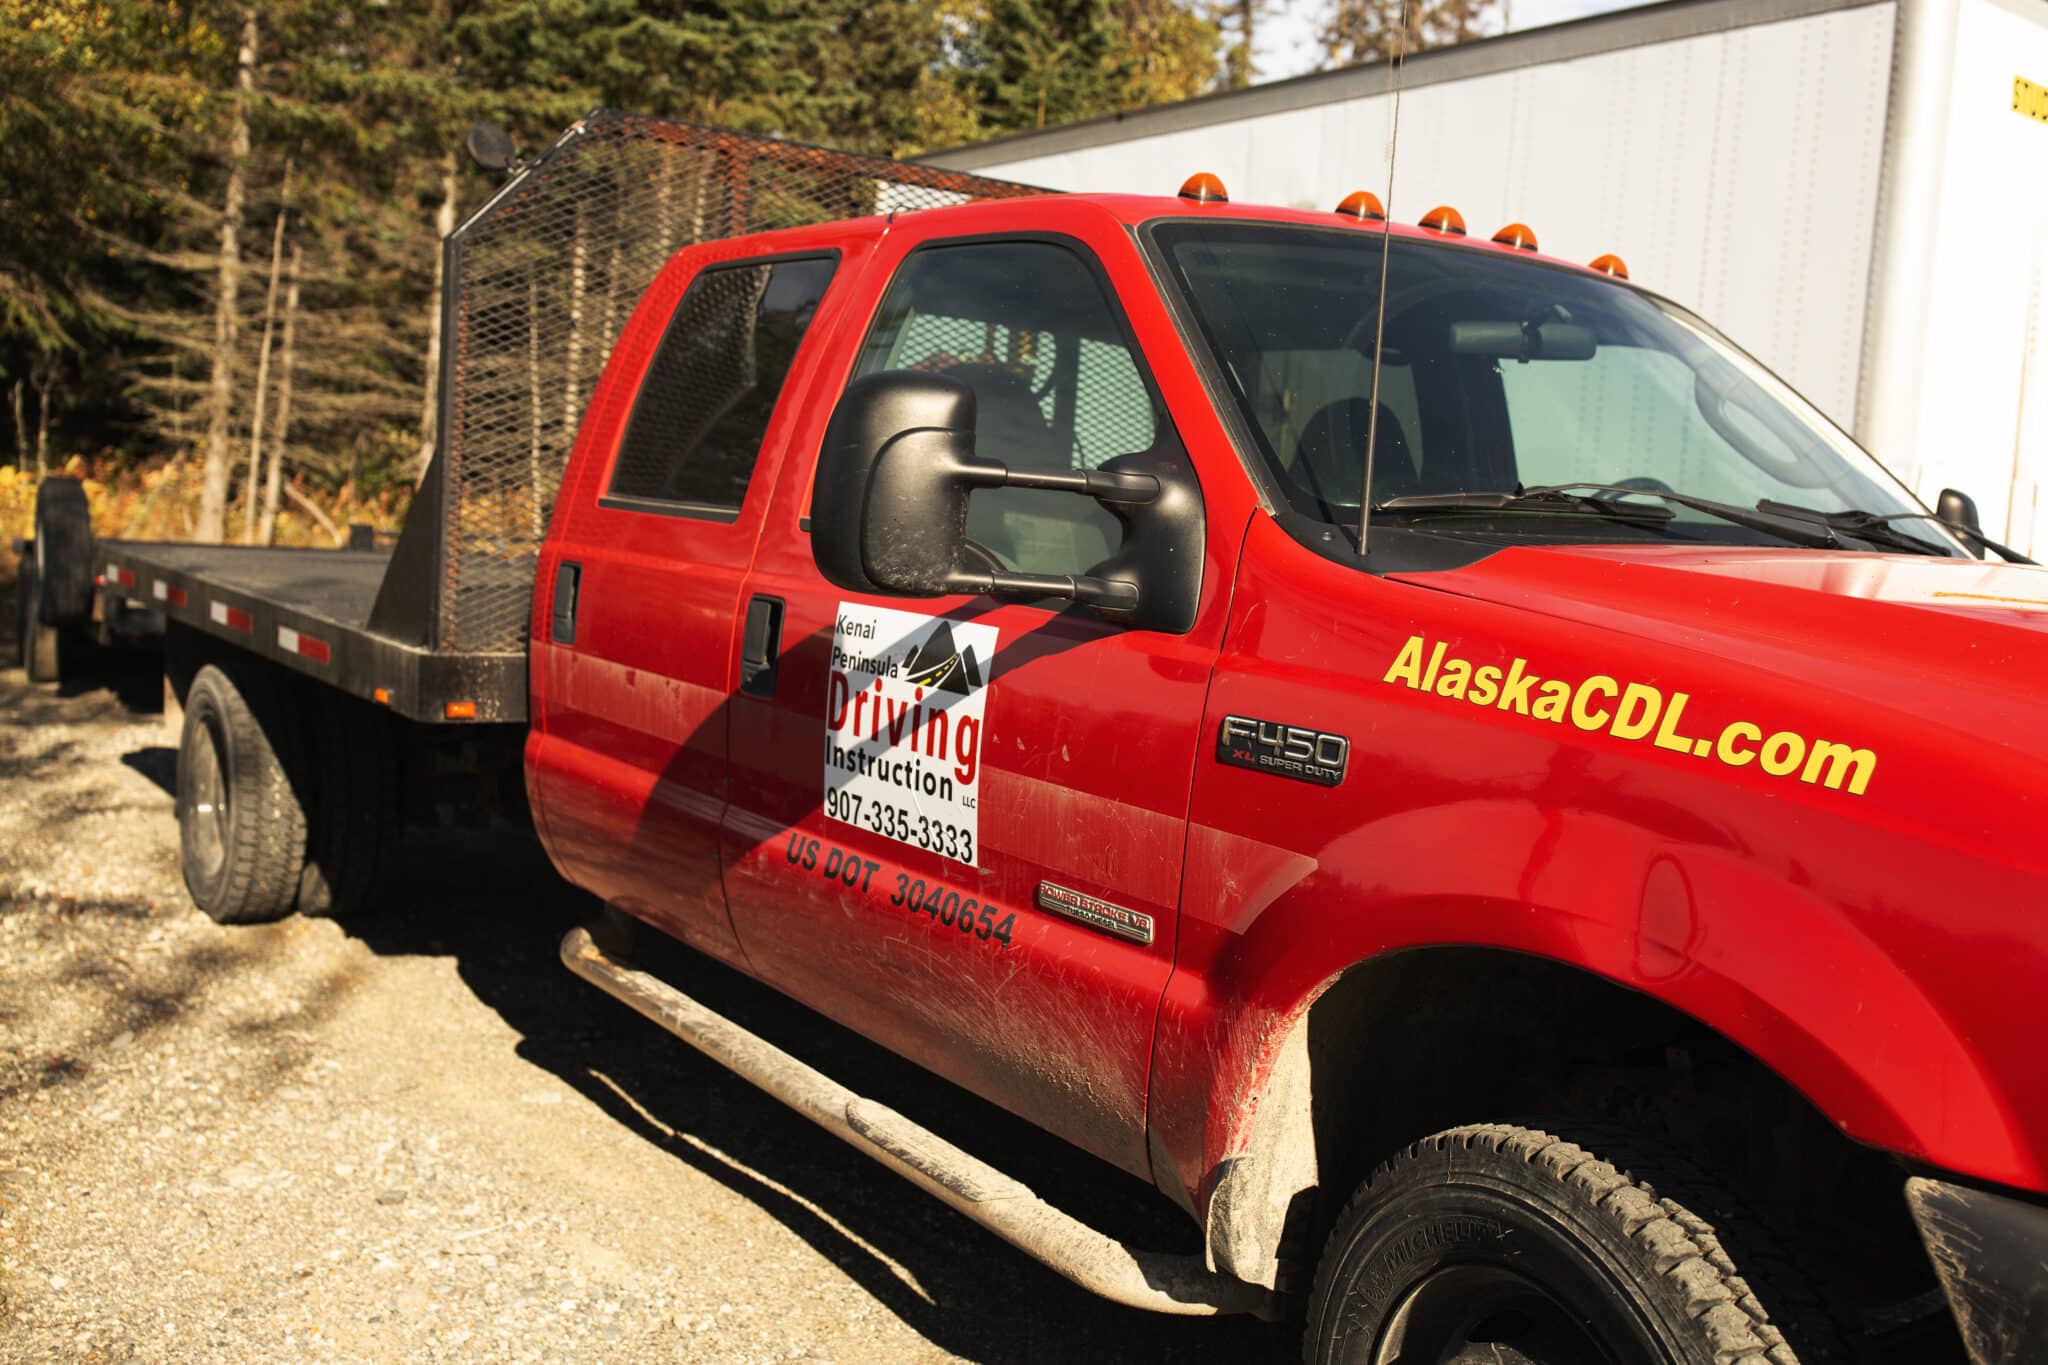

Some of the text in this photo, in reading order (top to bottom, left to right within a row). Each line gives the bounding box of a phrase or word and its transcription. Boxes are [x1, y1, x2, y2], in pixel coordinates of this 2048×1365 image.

[835, 614, 877, 640] Kenai
[831, 645, 899, 679] Peninsula
[827, 670, 979, 786] Driving
[1221, 715, 1348, 768] F-450
[1383, 635, 1878, 796] AlaskaCDL.com
[826, 735, 953, 802] Instruction
[1232, 749, 1342, 781] XL SUPER DUTY
[827, 786, 973, 865] 907-335-3333
[962, 795, 976, 809] LLC
[786, 832, 822, 872] US
[823, 846, 880, 893] DOT
[889, 872, 1017, 948] 3040654
